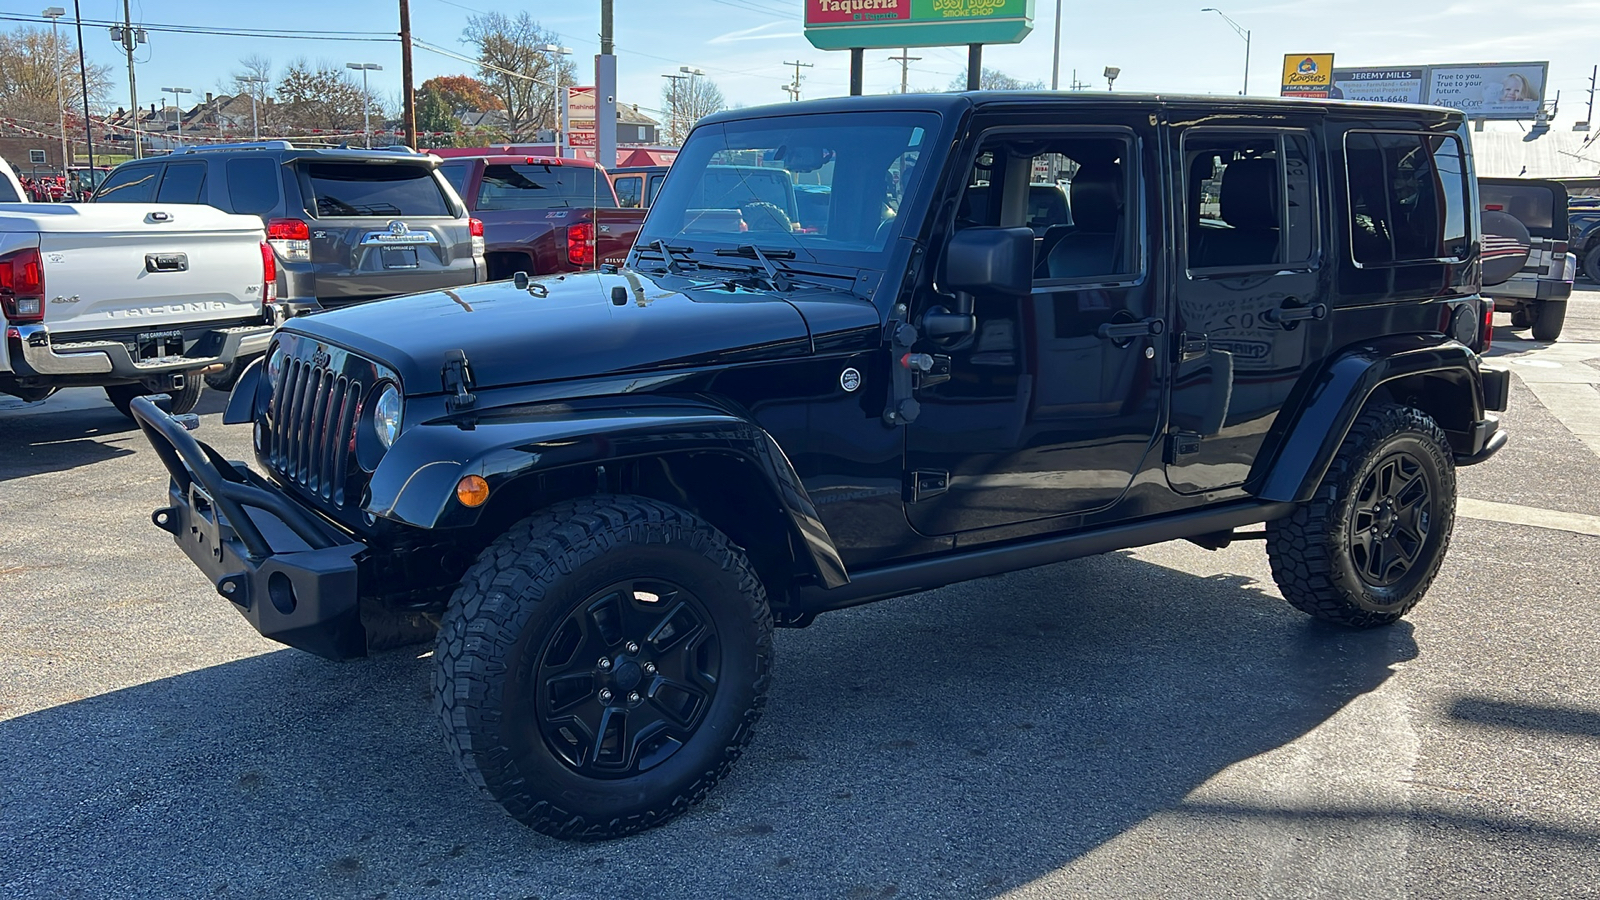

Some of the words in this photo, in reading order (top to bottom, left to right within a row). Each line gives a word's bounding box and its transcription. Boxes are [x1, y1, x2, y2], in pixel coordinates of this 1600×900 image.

[942, 9, 970, 18] SMOKE
[971, 8, 994, 16] SHOP
[1287, 72, 1326, 84] Roosters
[1351, 72, 1385, 80] JEREMY
[1386, 71, 1412, 79] MILLS
[1465, 74, 1482, 82] you.
[106, 300, 226, 319] TACOMA
